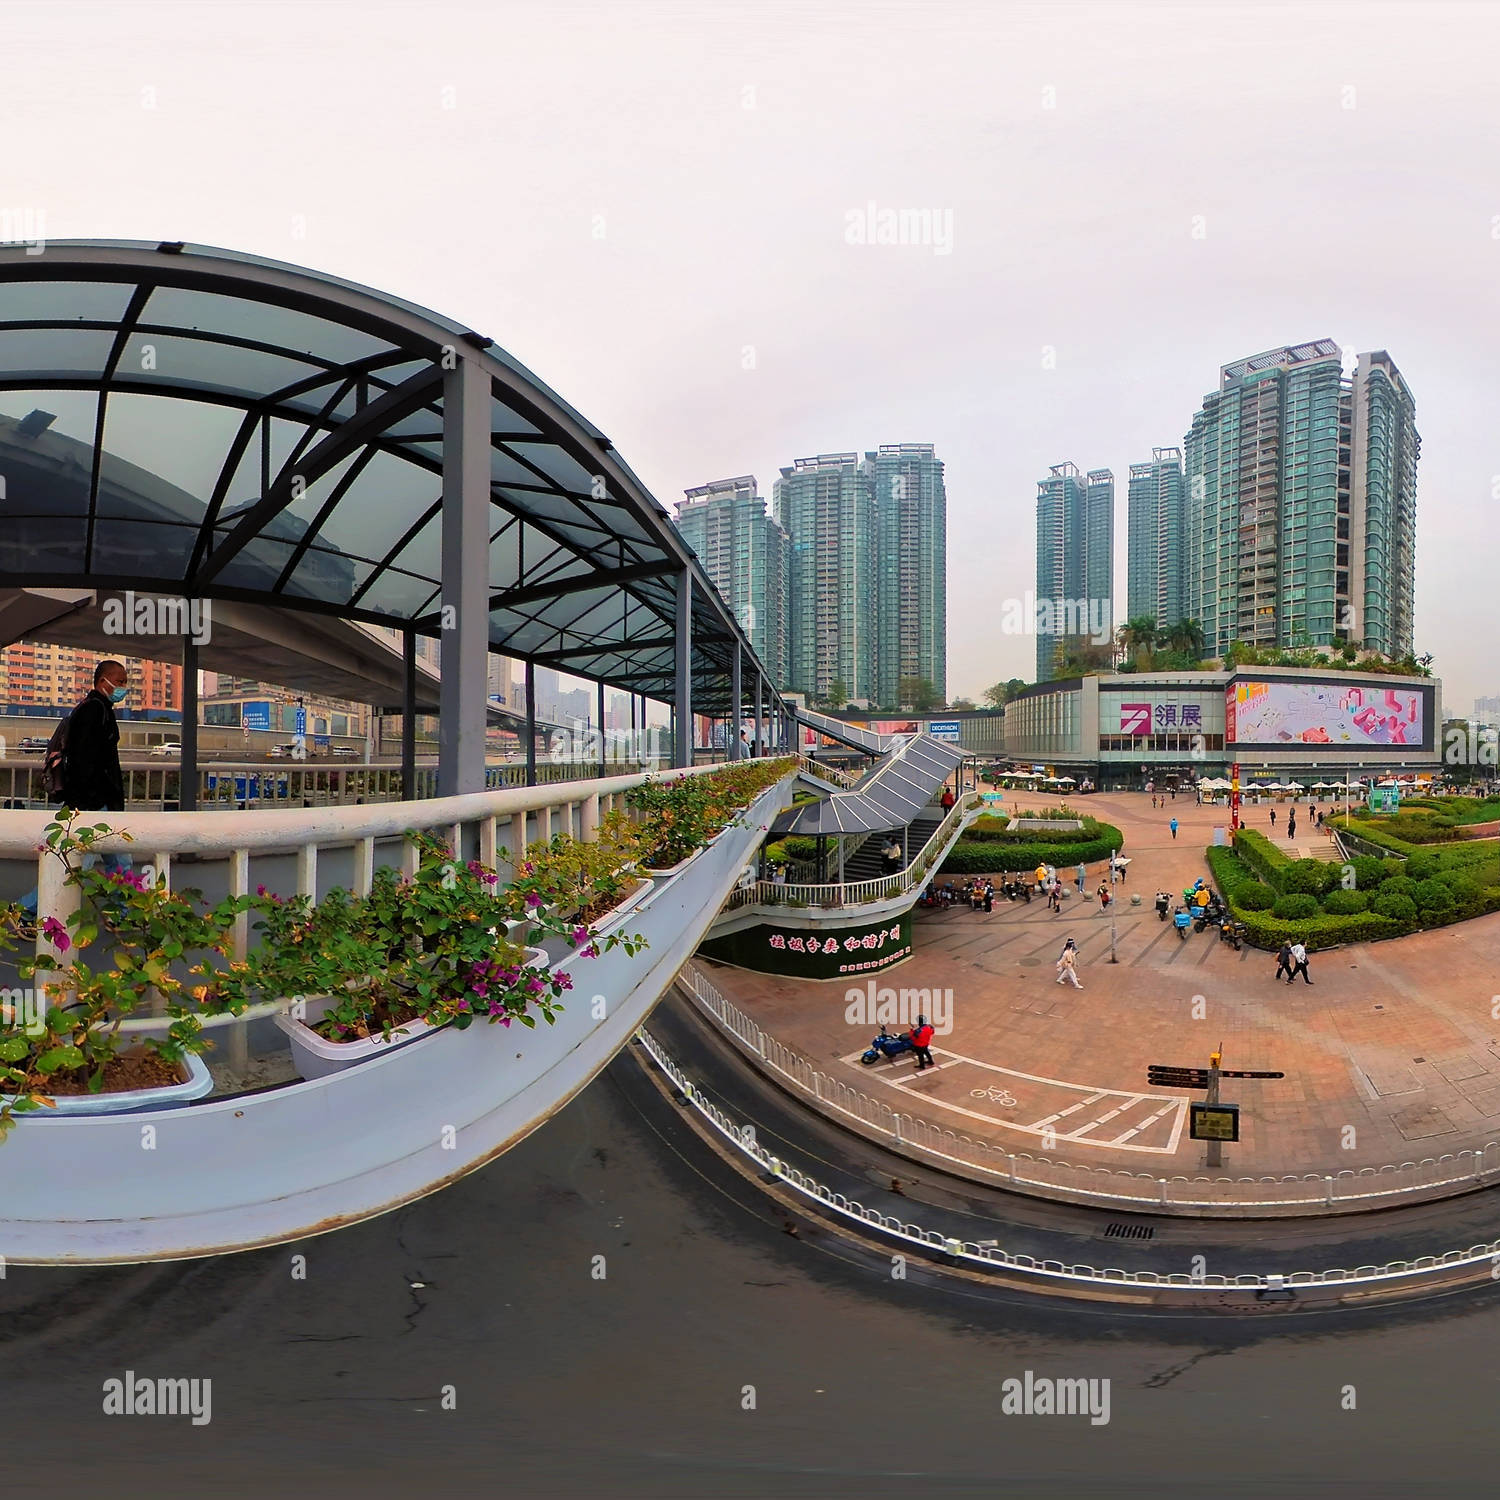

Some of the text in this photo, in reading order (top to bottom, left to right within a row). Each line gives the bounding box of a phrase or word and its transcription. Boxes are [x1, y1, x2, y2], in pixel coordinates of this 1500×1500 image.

[1155, 704, 1202, 726] 領展
[769, 924, 900, 954] 垃圾分类 和谐广州
